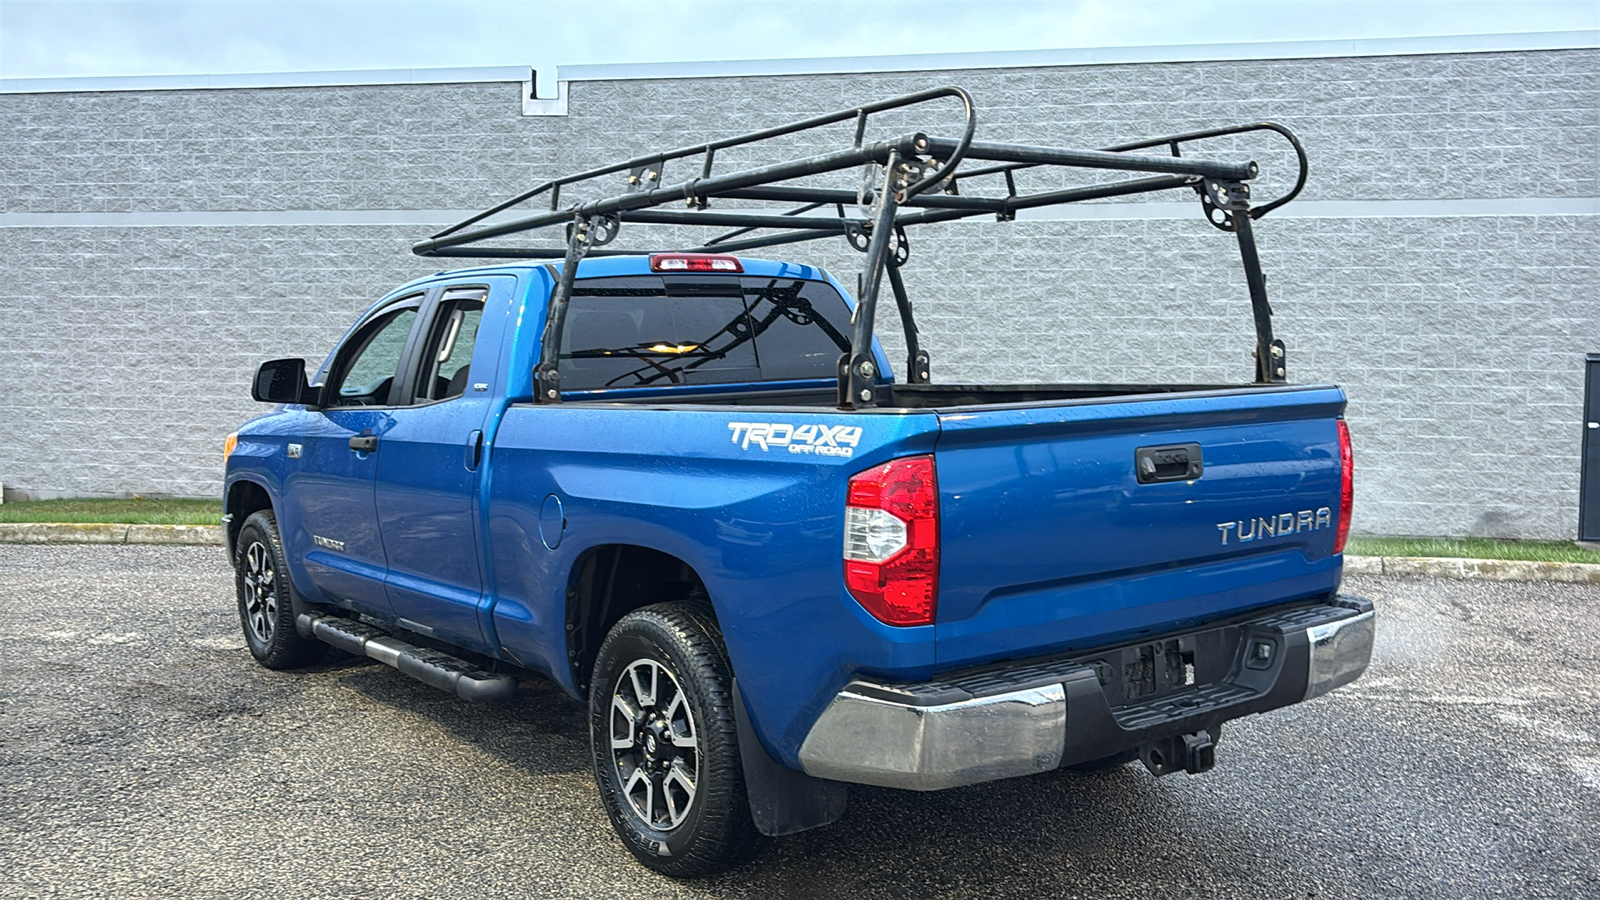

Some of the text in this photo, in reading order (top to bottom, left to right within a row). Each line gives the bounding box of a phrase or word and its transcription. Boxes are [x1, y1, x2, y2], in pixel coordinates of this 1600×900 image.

[788, 443, 853, 457] OFF ROAD
[1216, 506, 1331, 545] TUNDRA
